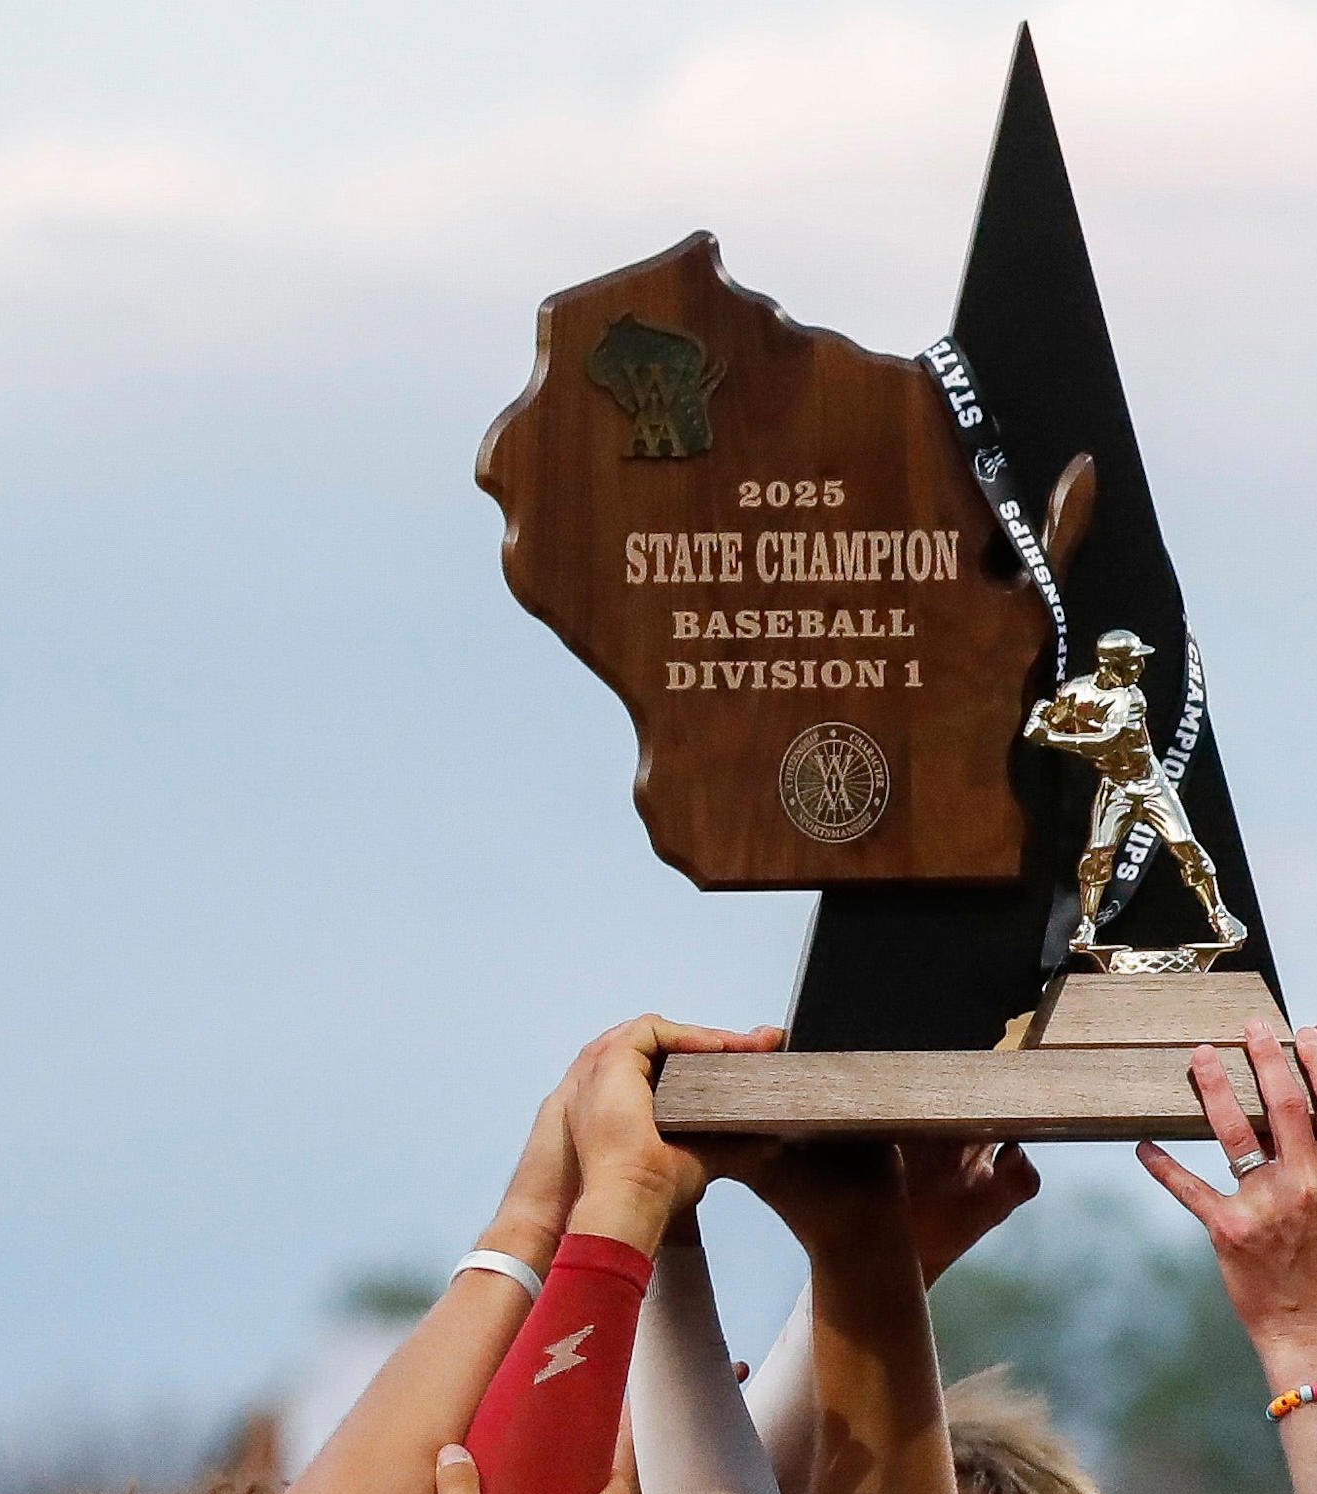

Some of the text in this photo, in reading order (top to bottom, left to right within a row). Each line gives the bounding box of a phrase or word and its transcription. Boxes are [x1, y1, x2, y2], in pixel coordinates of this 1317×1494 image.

[738, 479, 847, 508] 2025
[625, 529, 960, 584] STATE CHAMPION
[672, 608, 916, 640] BASEBALL
[665, 658, 924, 691] DIVISION 1
